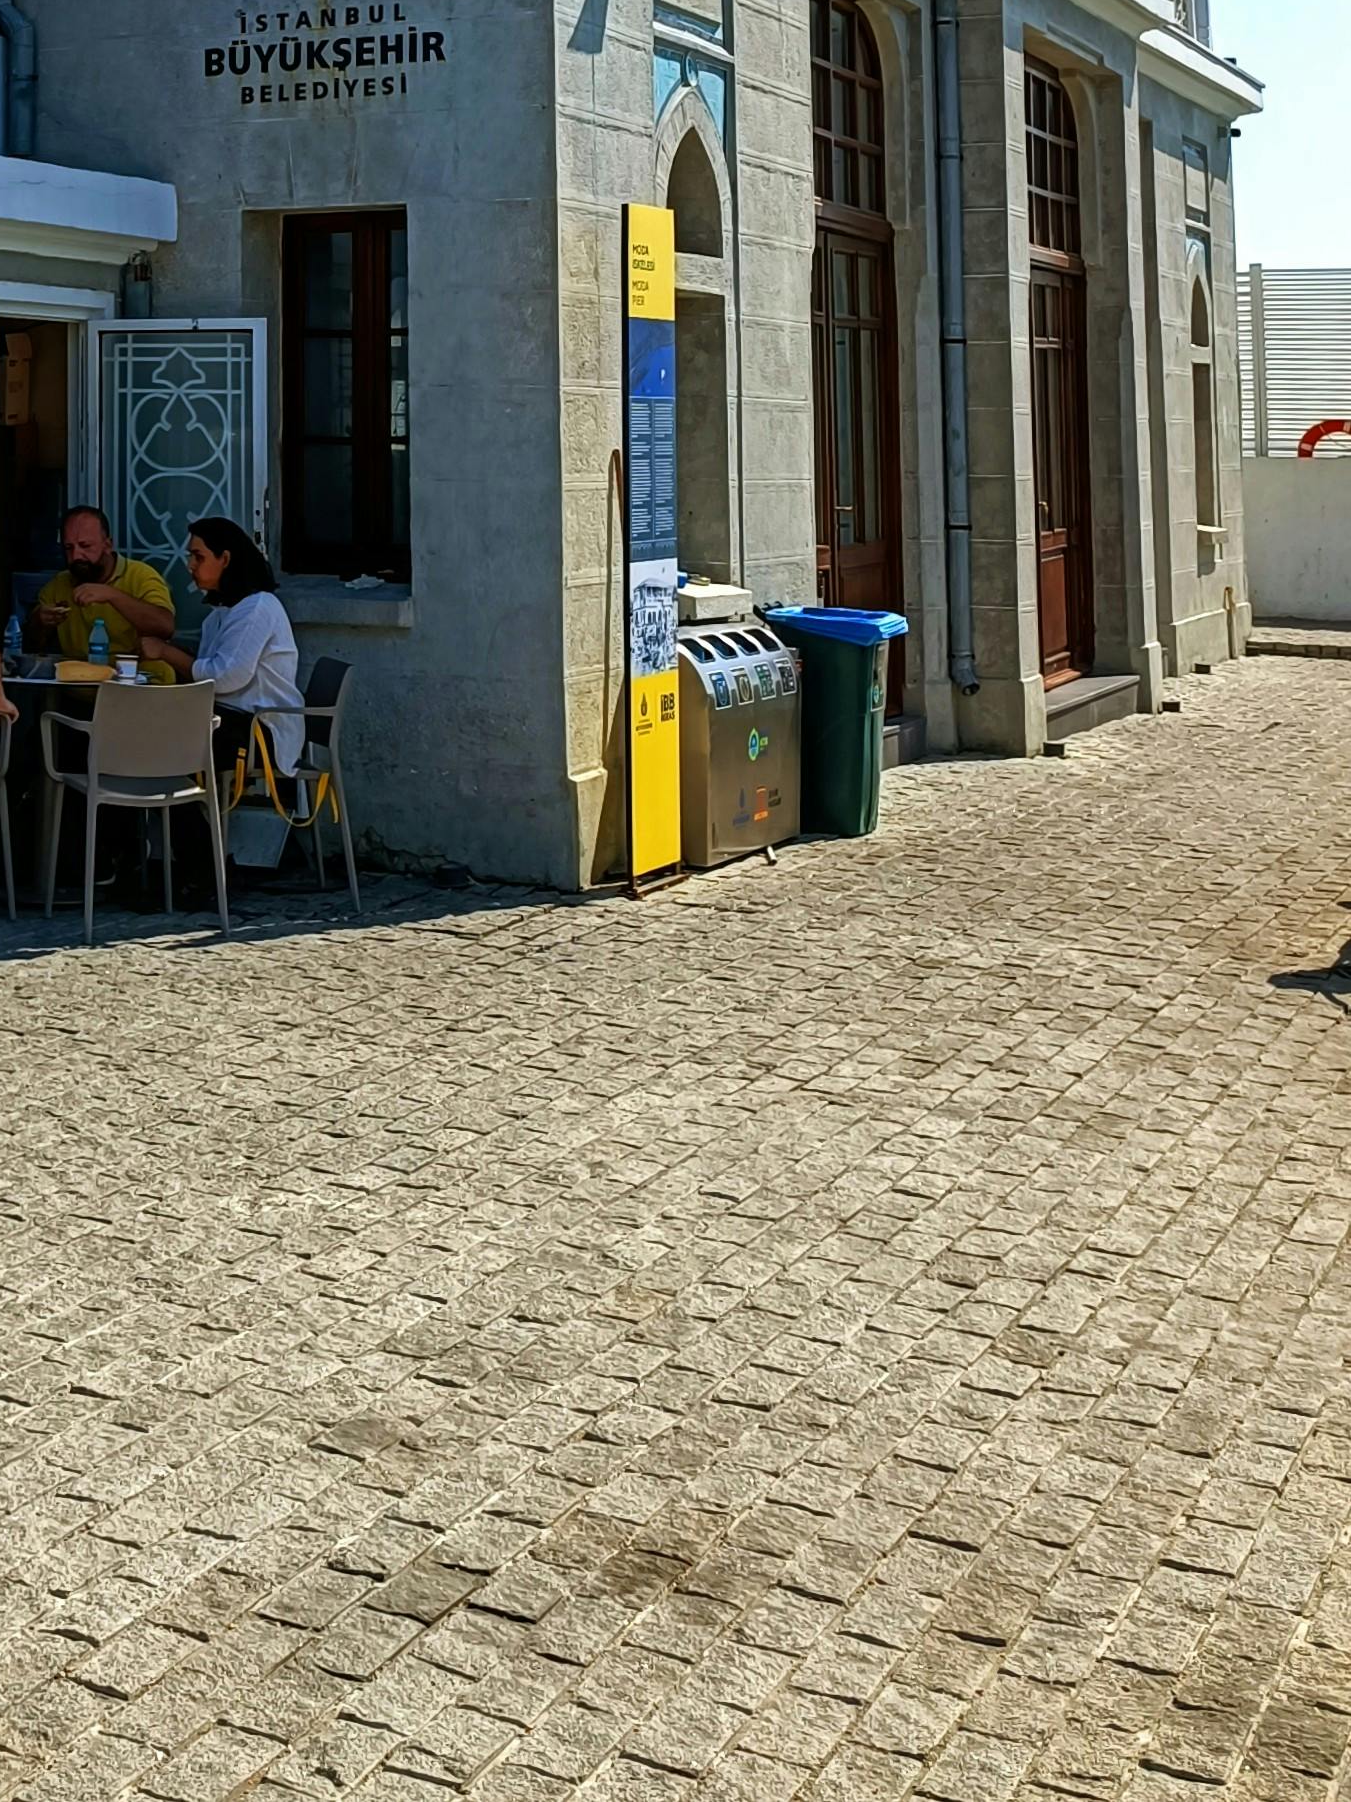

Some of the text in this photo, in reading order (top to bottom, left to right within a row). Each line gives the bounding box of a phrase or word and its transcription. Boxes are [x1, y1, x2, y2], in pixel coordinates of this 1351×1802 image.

[238, 2, 407, 34] İSTANBUL
[203, 26, 446, 77] BÜYÜKŞEHİR
[240, 72, 408, 105] BELEDİYESİ
